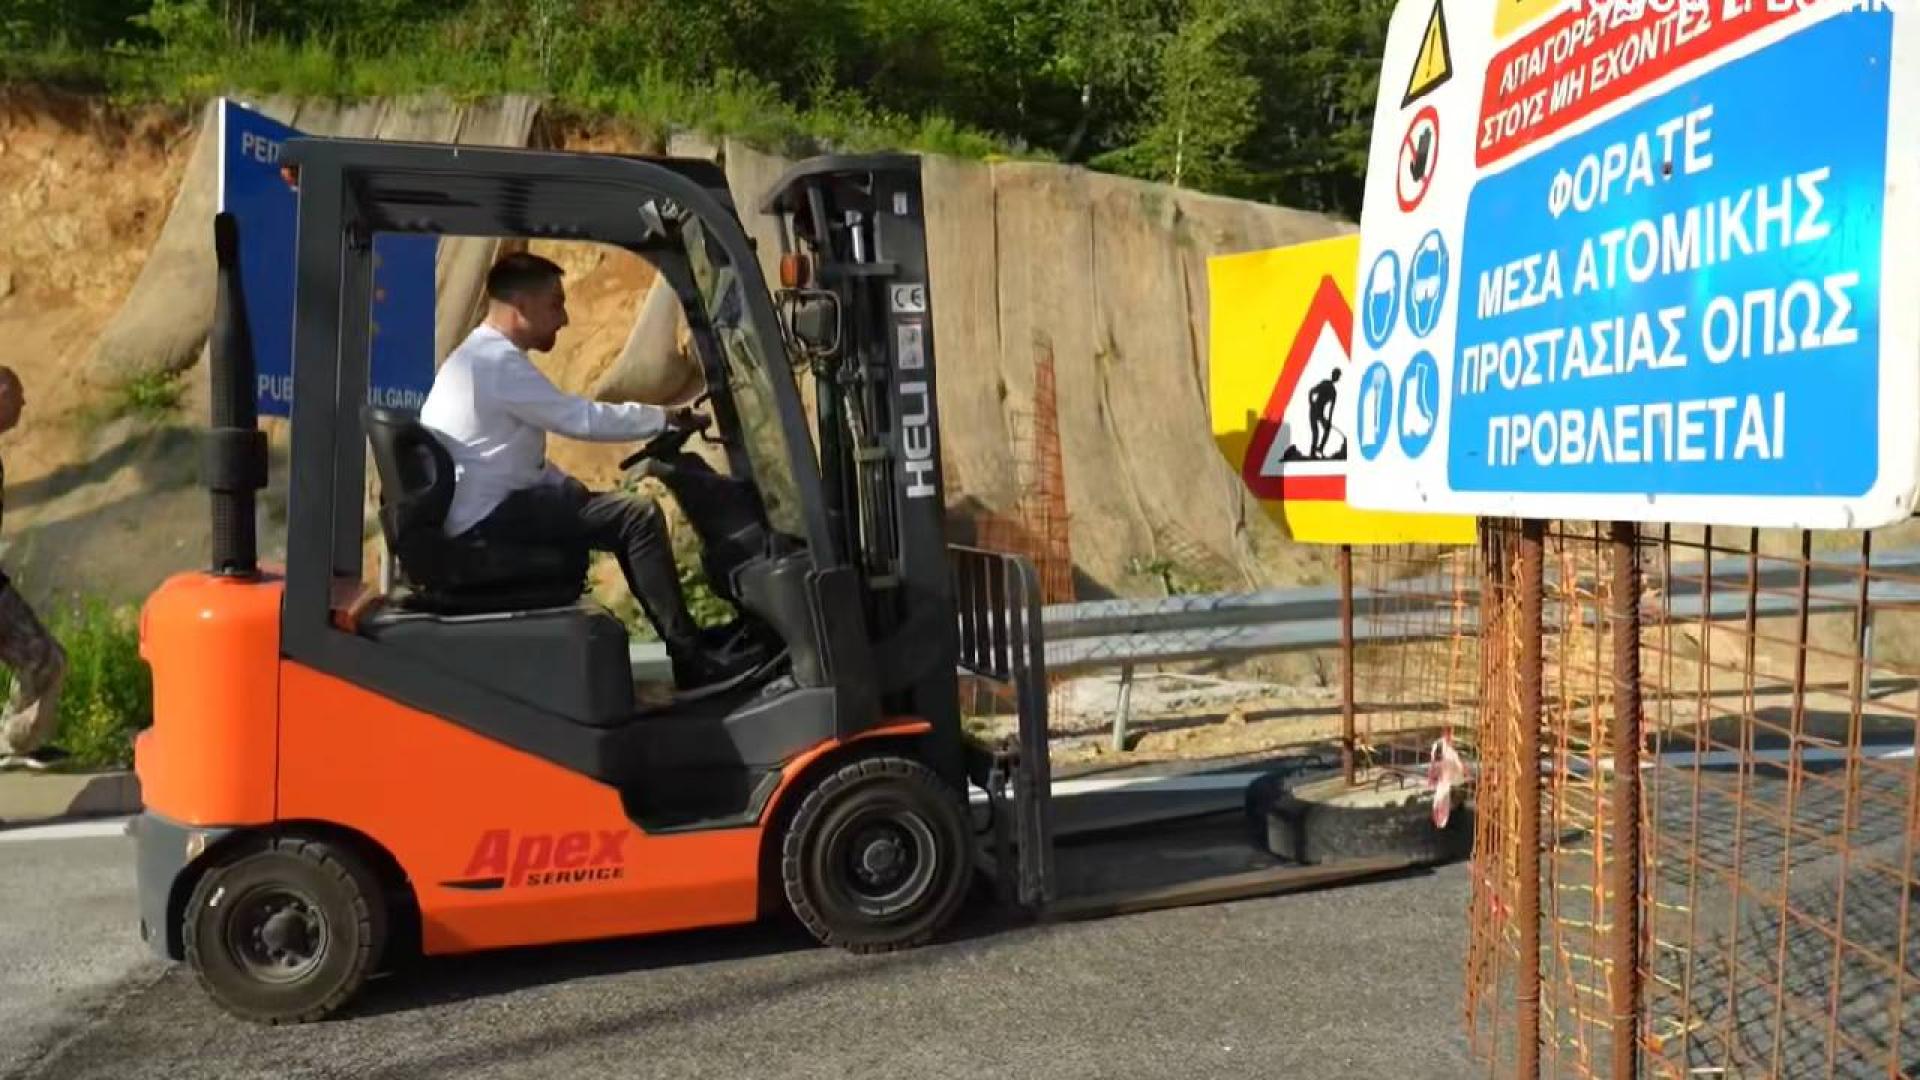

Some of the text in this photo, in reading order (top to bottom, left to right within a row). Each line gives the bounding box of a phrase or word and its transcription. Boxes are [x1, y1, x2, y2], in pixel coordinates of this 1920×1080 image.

[1480, 88, 1549, 149] ΣΤΟΥΣ
[1550, 64, 1586, 116] ΜΗ
[1547, 104, 1714, 219] ΦΟΡΑΤΕ
[1476, 166, 1832, 320] ΜΕΣΑ ΑΤΟΜΙΚΗΣ
[1460, 271, 1860, 396] ΠΡΟΣΤΑΣΙΑΣ ΟΠΩΣ
[1486, 391, 1787, 468] ΠΡΟΒΛΕΠΕΤΑΙ
[464, 828, 630, 889] Apex
[527, 866, 625, 886] SERVICE
